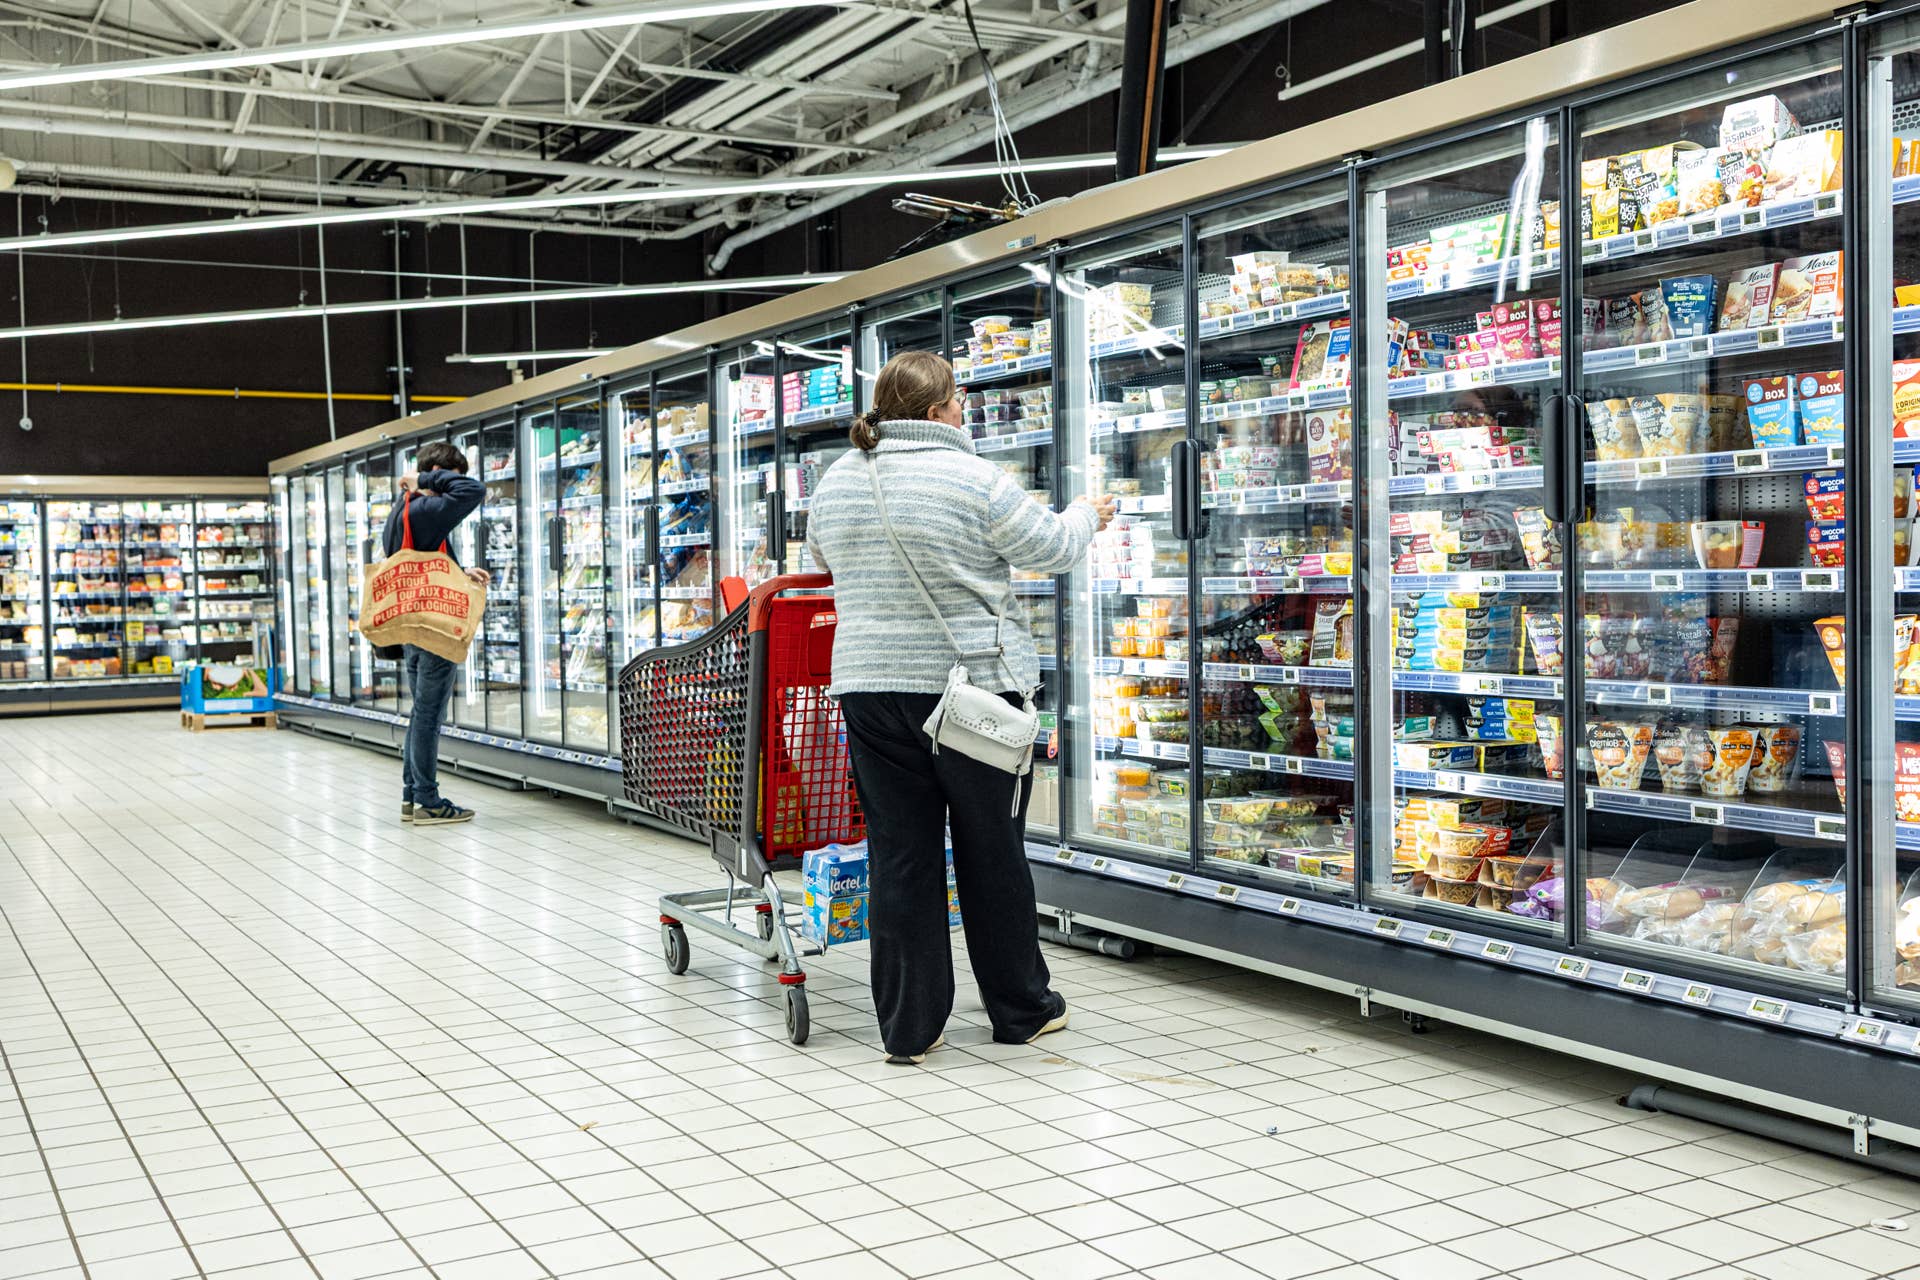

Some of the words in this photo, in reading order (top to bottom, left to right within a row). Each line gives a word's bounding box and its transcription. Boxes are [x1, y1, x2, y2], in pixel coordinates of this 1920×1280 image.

[1797, 256, 1837, 272] Marie
[1741, 270, 1771, 285] Marie
[1509, 310, 1527, 321] BOX
[1764, 389, 1786, 400] BOX
[1819, 383, 1842, 395] BOX
[373, 567, 400, 588] STOP
[400, 562, 420, 574] AUX
[423, 559, 449, 573] SACS
[374, 576, 428, 602] PLASTIQUE
[400, 590, 416, 601] OUI
[419, 587, 441, 598] AUX
[443, 589, 468, 605] SACS
[374, 608, 399, 625] PLUS
[830, 875, 860, 894] lactel
